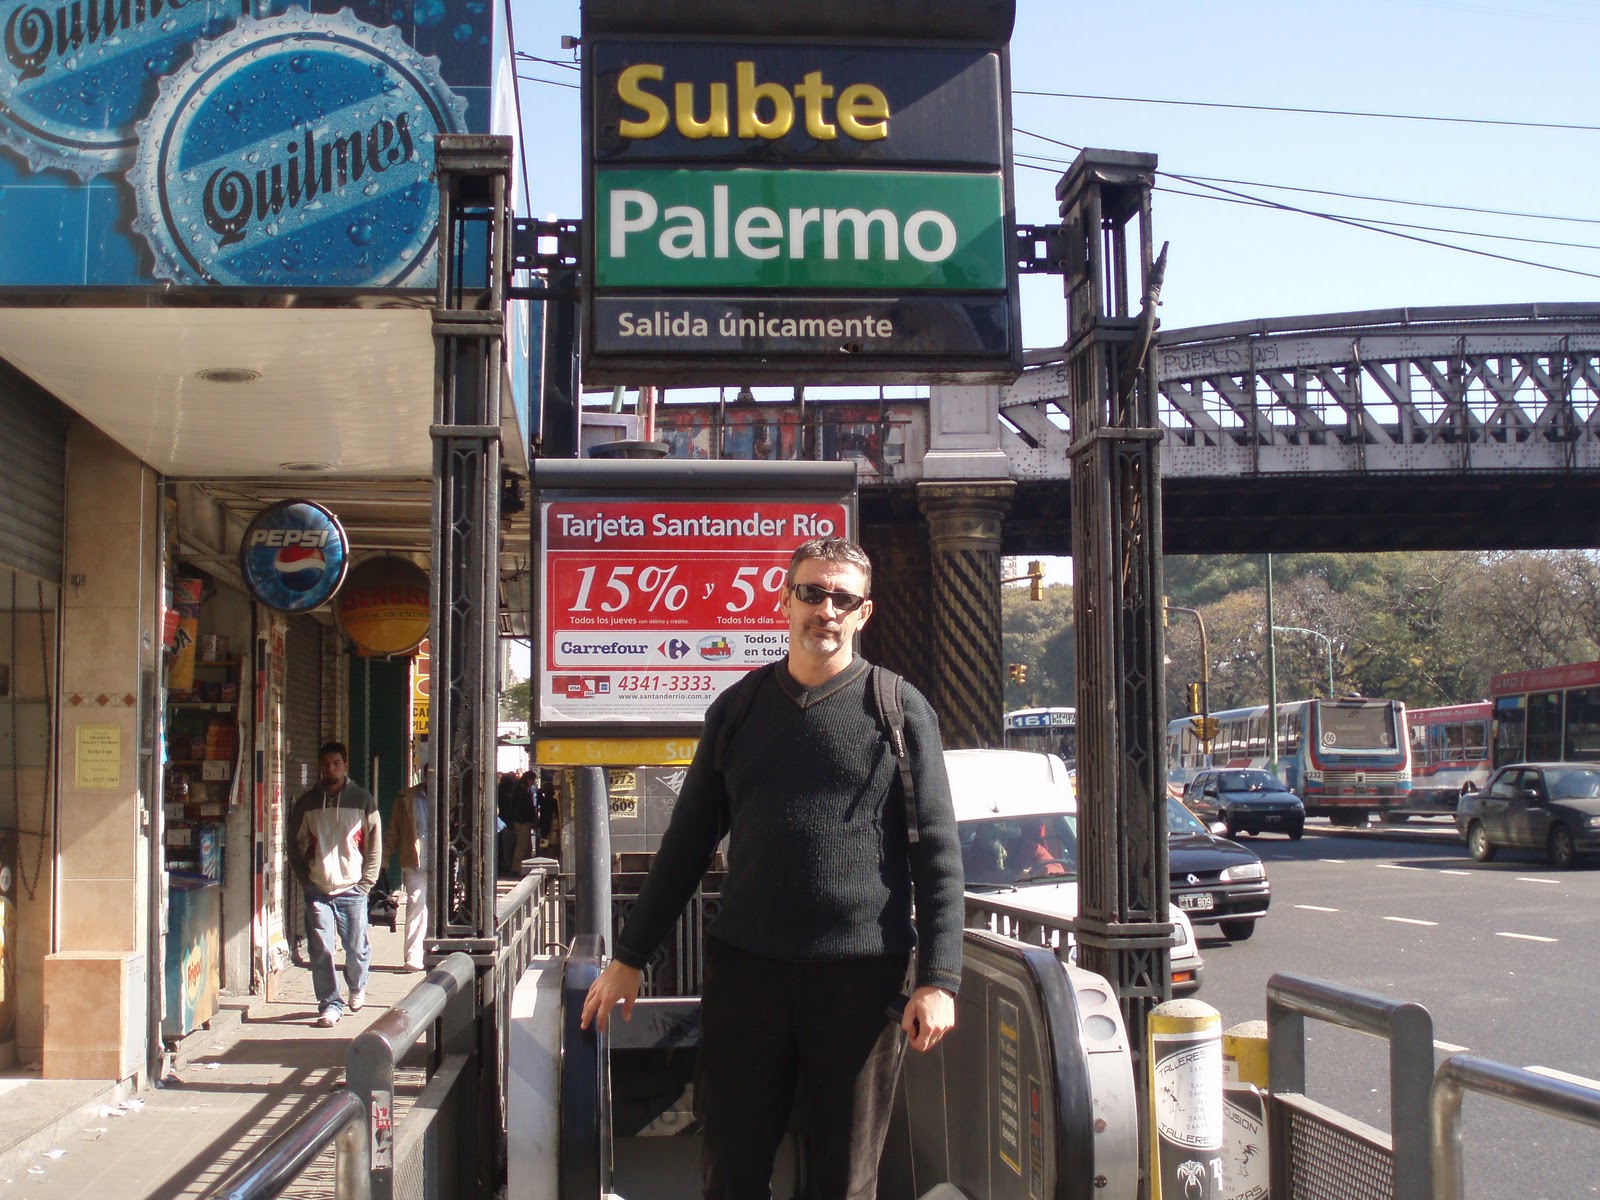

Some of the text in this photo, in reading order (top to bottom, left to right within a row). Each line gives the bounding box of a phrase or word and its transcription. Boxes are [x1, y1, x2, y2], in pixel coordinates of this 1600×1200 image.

[617, 61, 890, 140] Subte
[202, 111, 414, 247] Quilmes
[609, 185, 957, 262] Palermo
[618, 312, 893, 338] Salida únicamente
[557, 512, 834, 542] Tarjeta Santander Río
[249, 529, 330, 547] PEPSI
[567, 564, 689, 613] 15%
[702, 582, 715, 599] y
[570, 616, 595, 624] Todos
[597, 616, 608, 624] los
[610, 616, 636, 626] jueves
[716, 616, 742, 624] Todos
[744, 616, 755, 624] los
[757, 616, 774, 624] días
[560, 641, 648, 654] Carrefour
[744, 634, 789, 643] Todos lo
[618, 675, 716, 691] 4341-3333.
[618, 692, 712, 700] www.santanderrio.com.ar
[1015, 715, 1050, 726] 161
[1325, 734, 1335, 743] 60
[1158, 1050, 1205, 1078] TALLERES
[1160, 1122, 1210, 1145] TALLERE
